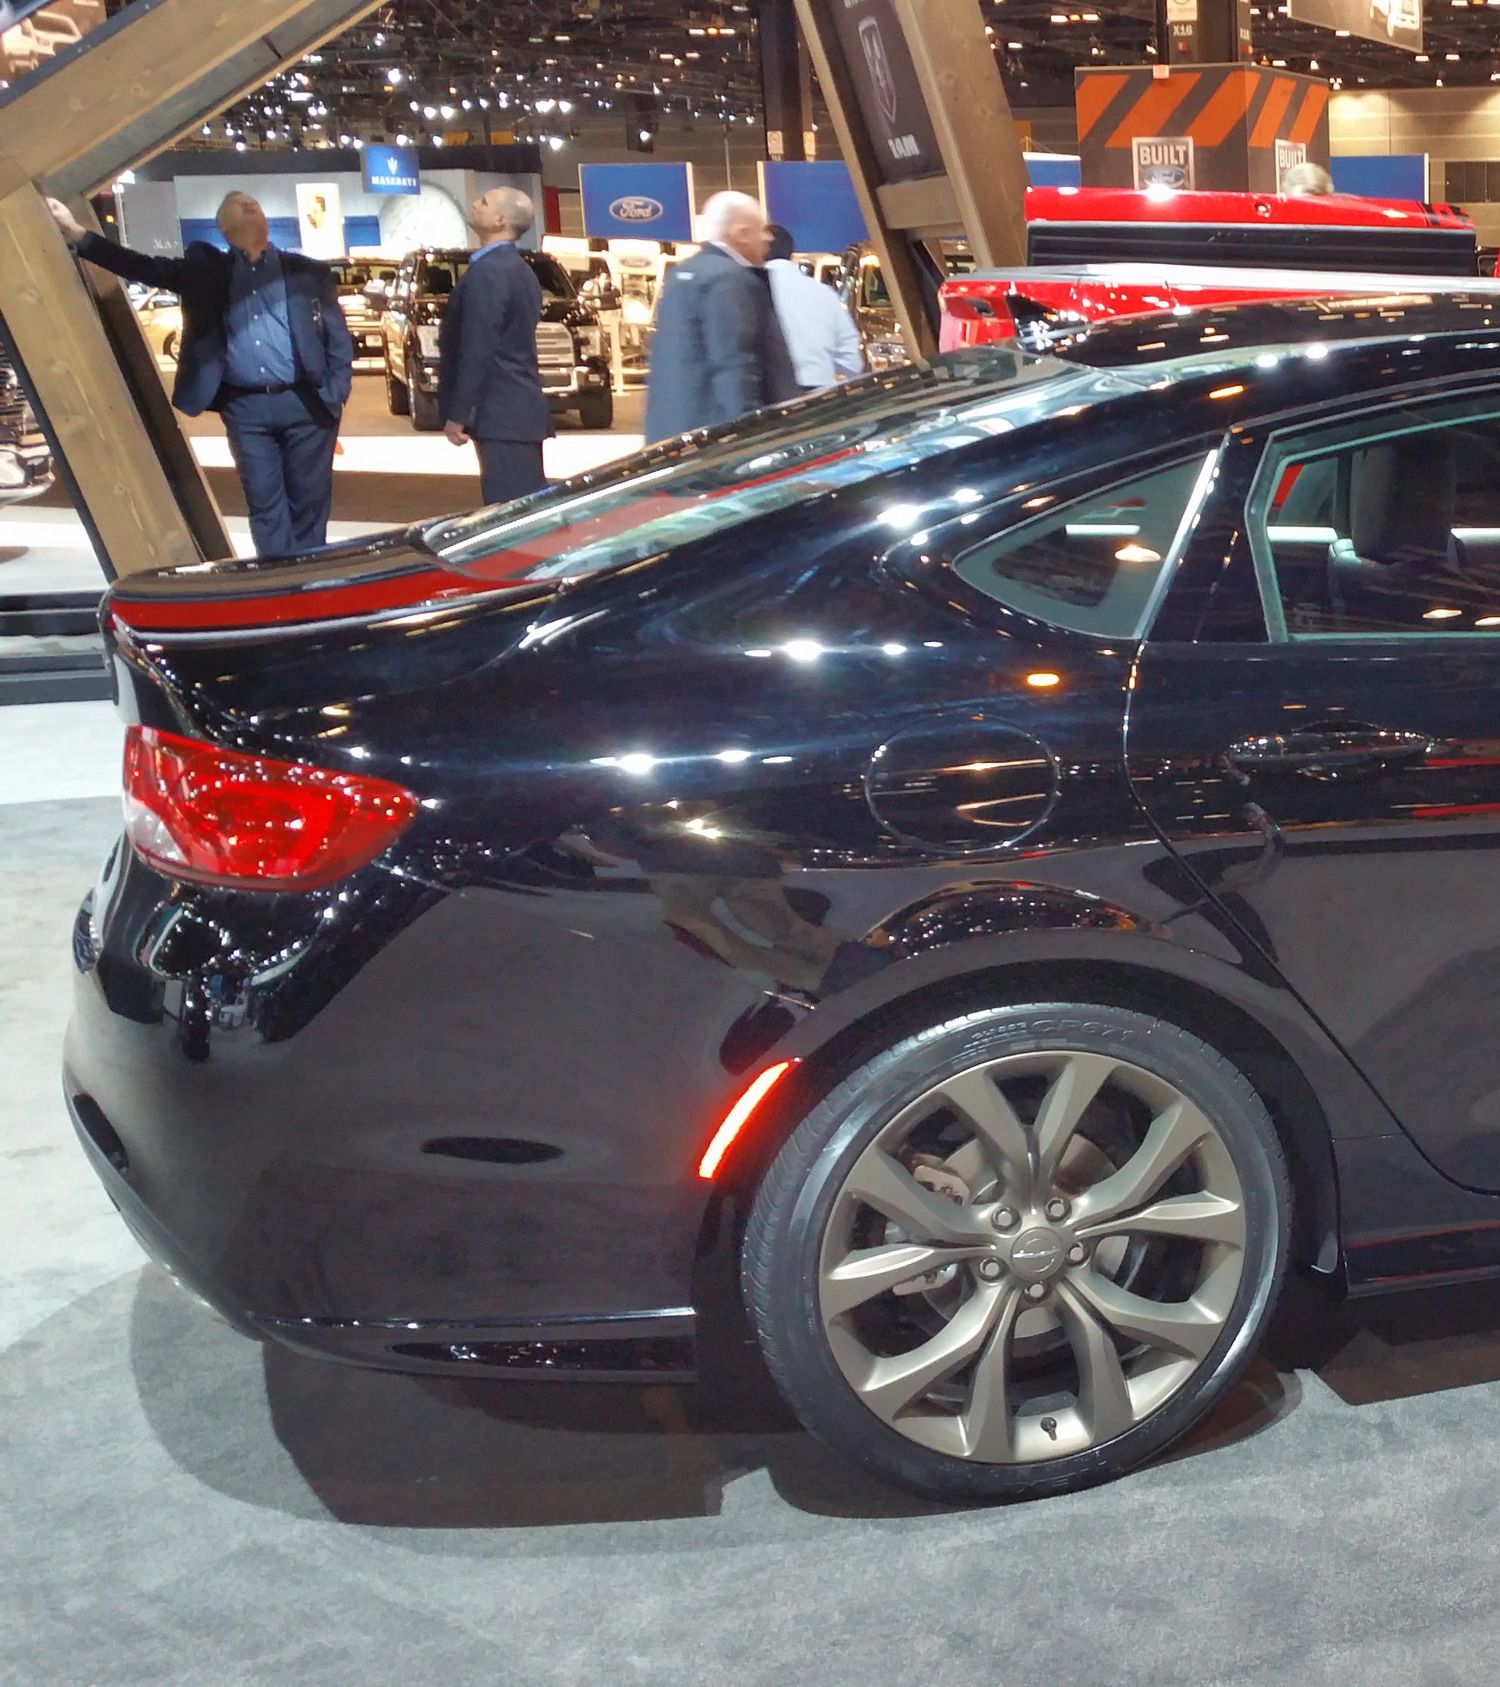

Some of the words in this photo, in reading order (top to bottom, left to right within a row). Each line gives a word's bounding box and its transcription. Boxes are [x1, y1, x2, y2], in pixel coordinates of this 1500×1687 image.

[1139, 145, 1187, 165] BUILT
[1279, 149, 1304, 169] BUILT
[371, 175, 417, 187] MASERATI
[620, 199, 653, 218] Ford
